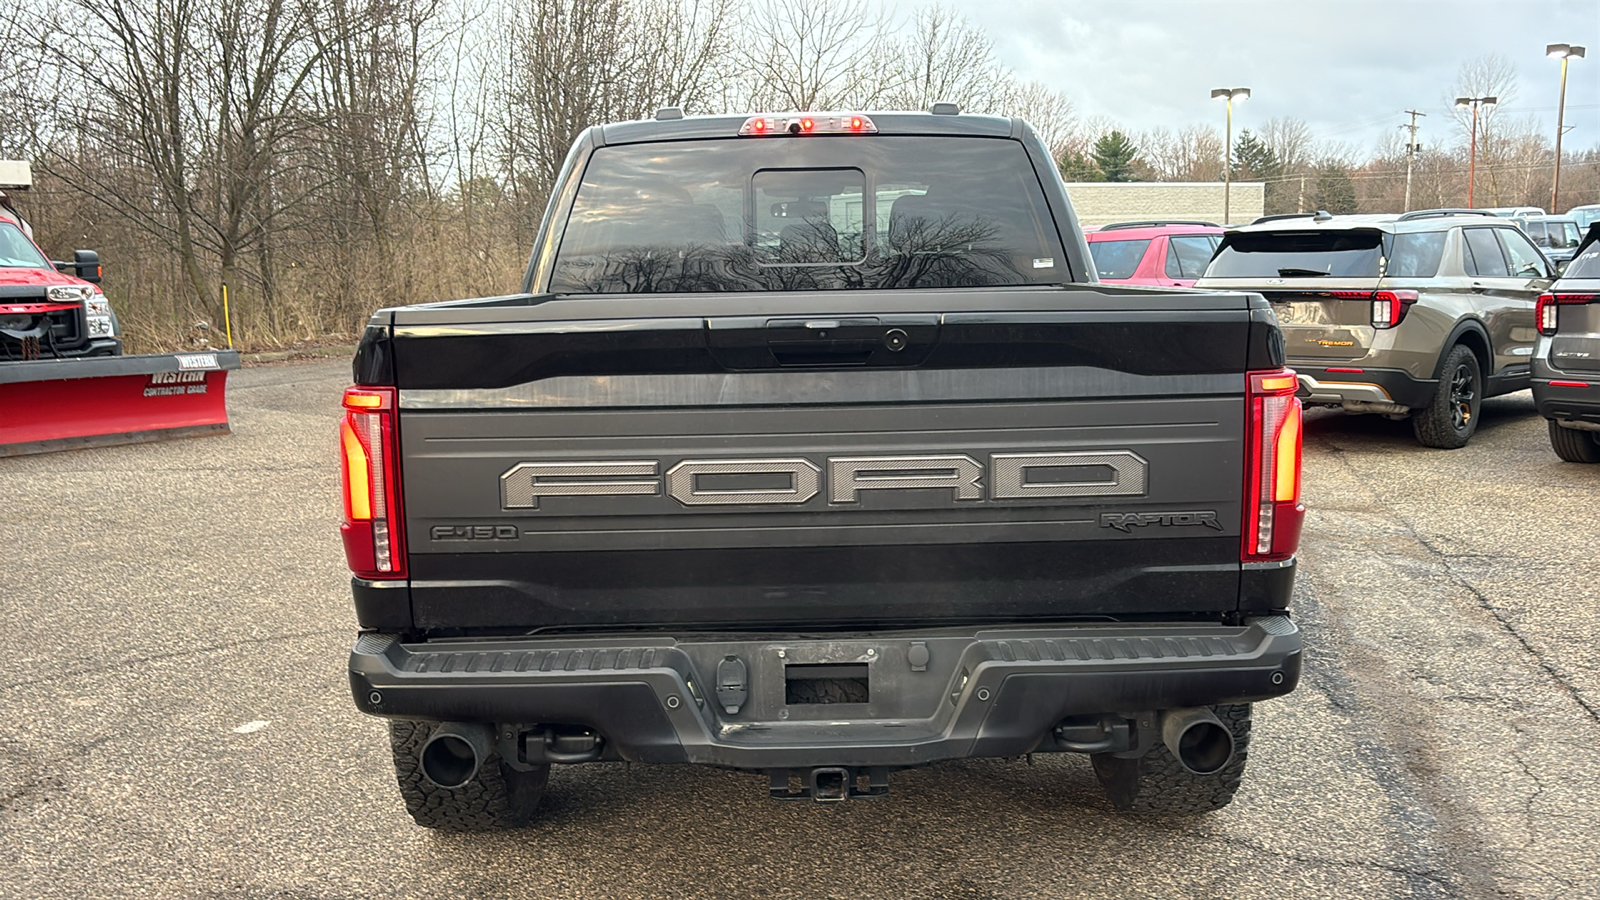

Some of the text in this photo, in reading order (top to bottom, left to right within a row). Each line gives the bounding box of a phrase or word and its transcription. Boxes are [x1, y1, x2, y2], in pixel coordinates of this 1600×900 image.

[180, 354, 217, 369] WESTERN
[151, 371, 206, 384] WESTERN
[143, 385, 208, 397] CONTRACTOR GRADE
[500, 449, 1149, 511] FORD
[1100, 509, 1223, 534] RAPTOR
[430, 525, 519, 541] F-150
